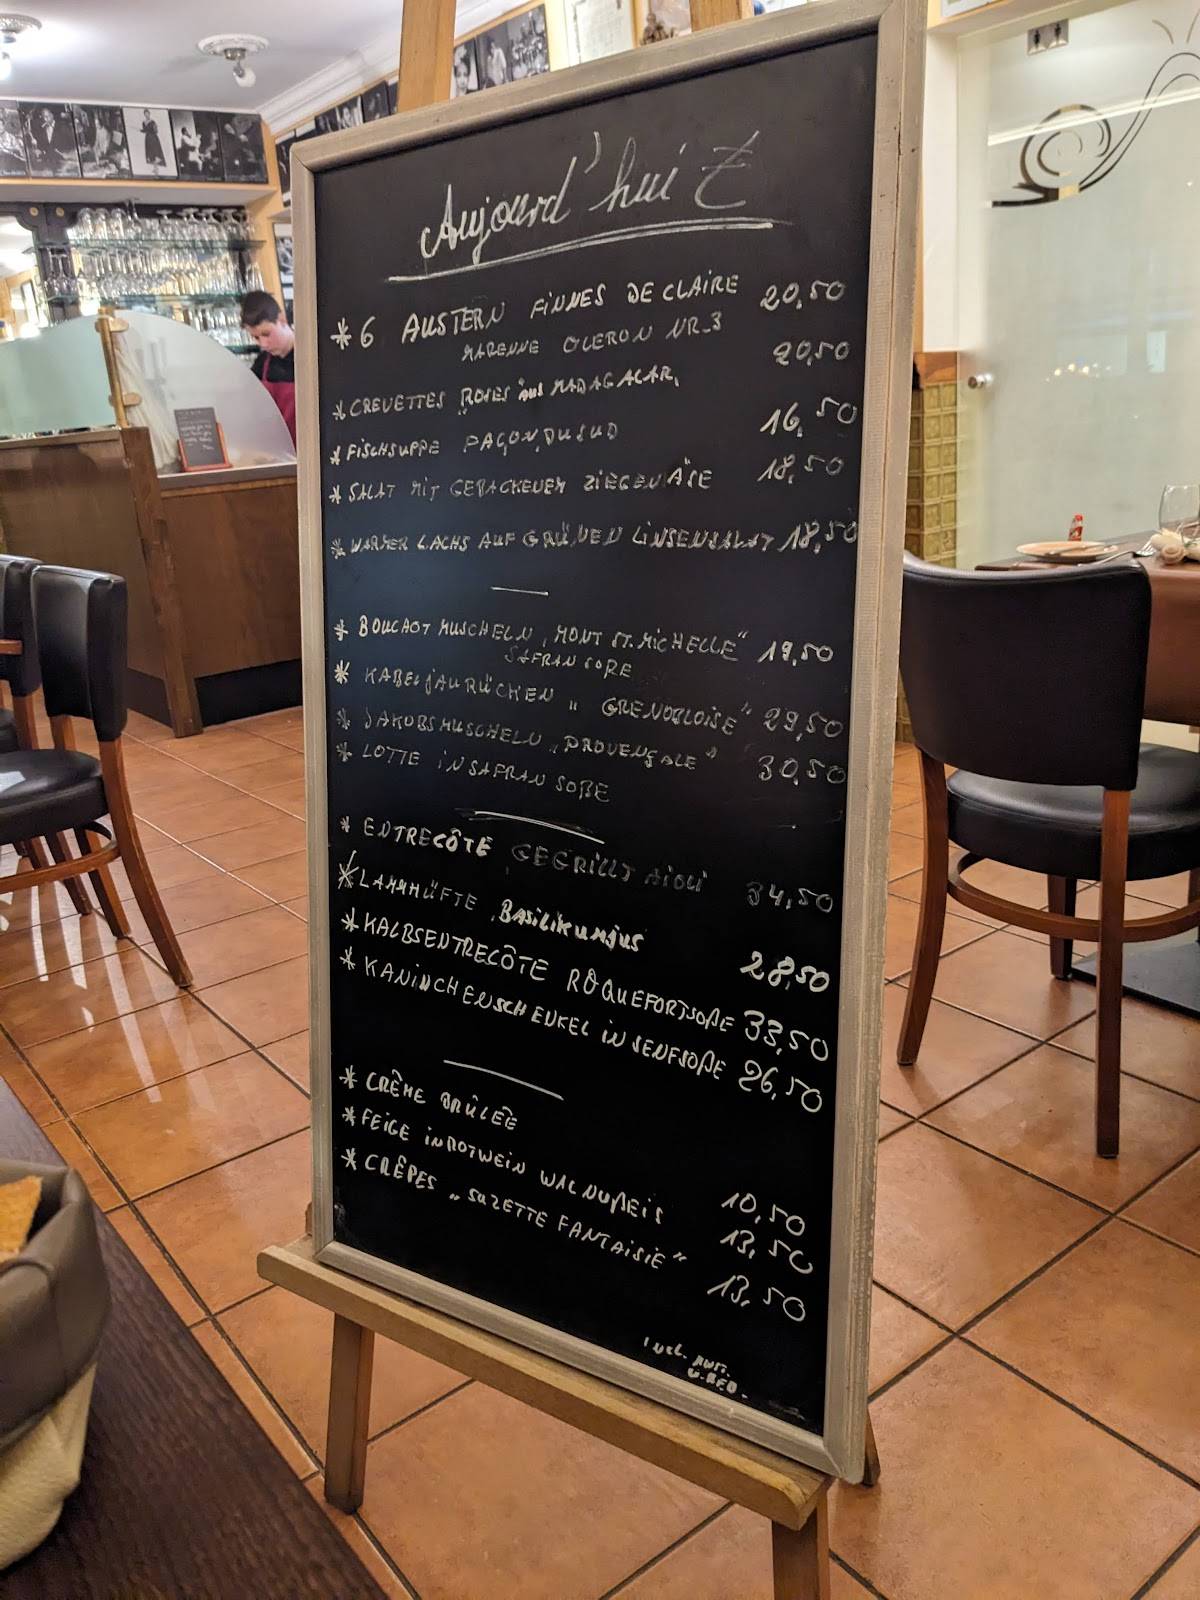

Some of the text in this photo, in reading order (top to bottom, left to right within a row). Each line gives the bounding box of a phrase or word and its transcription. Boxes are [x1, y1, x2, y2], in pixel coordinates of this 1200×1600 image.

[360, 316, 376, 348] 6
[402, 302, 505, 344] AUSTERN
[627, 282, 655, 304] DE
[760, 280, 846, 311] 20,50
[773, 340, 849, 367] 20,50
[350, 391, 446, 417] CREVETTES
[349, 482, 396, 502] SALAT
[417, 534, 471, 551] LACHS
[478, 532, 515, 549] AUF
[757, 641, 833, 666] 19,50
[763, 707, 843, 742] 29,50
[362, 743, 421, 766] LOTTE
[758, 755, 846, 784] 30,50
[364, 817, 493, 857] ENTRECÔTE
[740, 951, 830, 992] 28,50
[364, 912, 549, 981] KALBSENTRECÔTE
[744, 1009, 829, 1062] 33,50
[738, 1059, 822, 1113] 26,50
